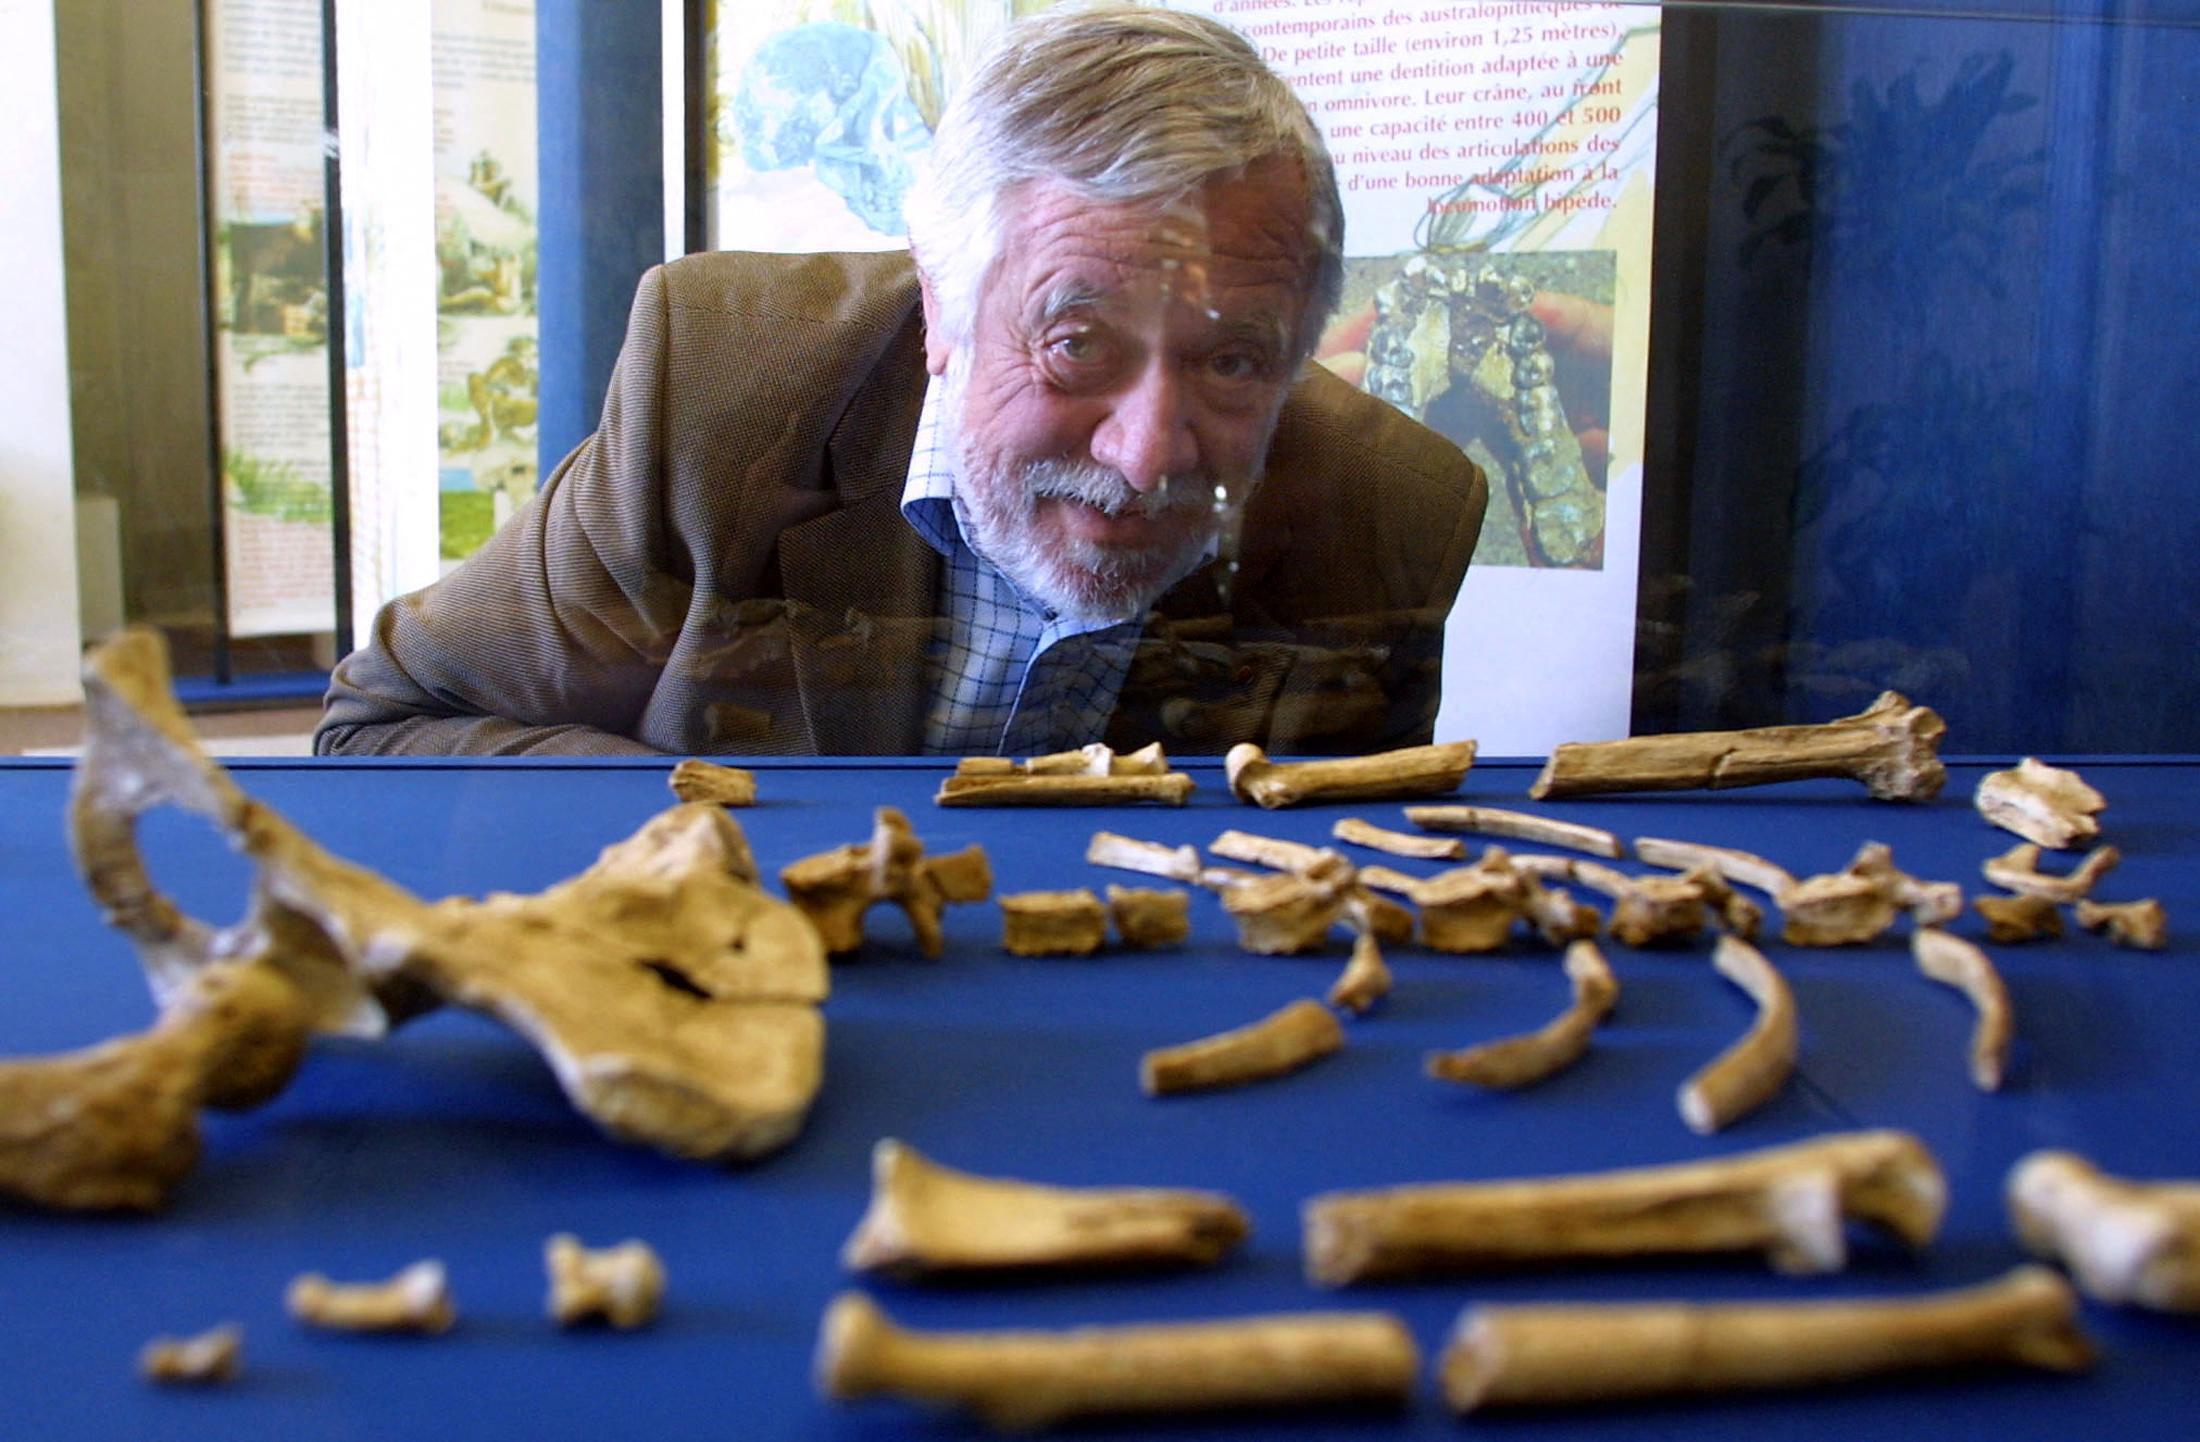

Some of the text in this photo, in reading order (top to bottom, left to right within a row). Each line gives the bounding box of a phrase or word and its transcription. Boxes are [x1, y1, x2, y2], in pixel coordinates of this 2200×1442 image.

[1242, 12, 1376, 38] contemporains
[1383, 9, 1412, 26] des
[1263, 47, 1288, 62] De
[1295, 43, 1346, 65] petite
[1353, 36, 1397, 56] taille
[1405, 32, 1483, 52] (environ
[1493, 26, 1533, 47] 1,25
[1351, 69, 1383, 83] une
[1391, 60, 1474, 80] dentition
[1481, 54, 1559, 77] adaptée
[1567, 51, 1578, 68] à
[1586, 52, 1623, 67] une
[1325, 92, 1417, 112] omnivore.
[1425, 89, 1465, 106] Leur
[1473, 82, 1533, 102] crâne,
[1541, 84, 1564, 98] au
[1573, 78, 1622, 96] front
[1331, 106, 1621, 140] une capacité entre 400 et 500
[1353, 146, 1411, 164] niveau
[1419, 142, 1449, 160] des
[1457, 137, 1578, 158] articulations
[1587, 134, 1620, 152] des
[1348, 161, 1618, 191] d'une bonne adaptation à la
[1428, 191, 1617, 215] locomotion bipède.
